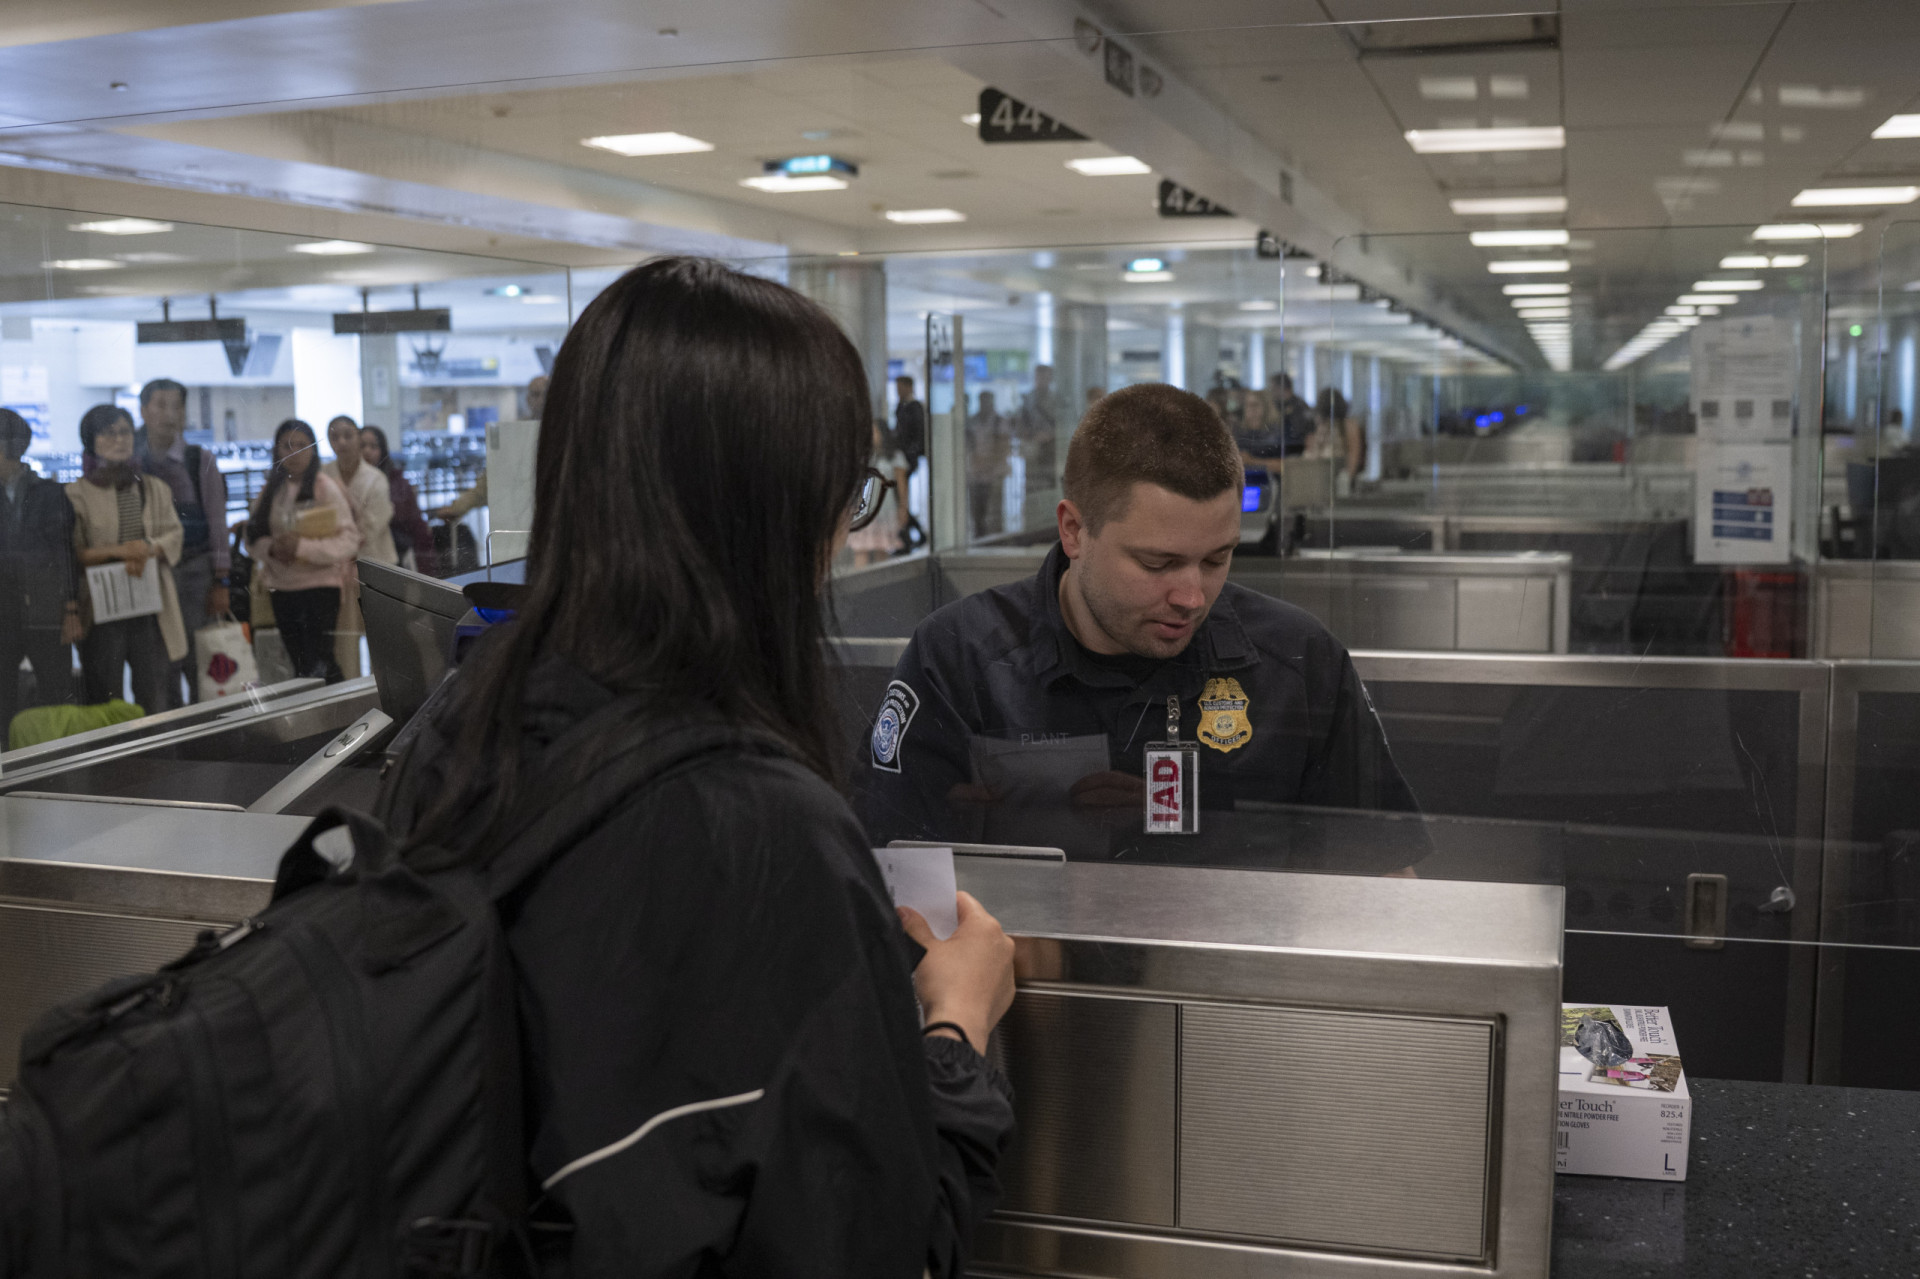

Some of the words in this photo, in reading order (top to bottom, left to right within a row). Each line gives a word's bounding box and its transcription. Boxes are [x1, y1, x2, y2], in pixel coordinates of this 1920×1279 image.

[1020, 732, 1069, 745] PLANT
[1211, 735, 1241, 744] OFFICER
[1153, 760, 1179, 822] IAD
[1559, 1100, 1574, 1110] er
[1564, 1111, 1583, 1119] NITRILE
[1607, 1114, 1619, 1122] FREE
[1660, 1110, 1683, 1119] 825.4
[1570, 1121, 1590, 1129] GLOVES
[1664, 1153, 1676, 1172] L
